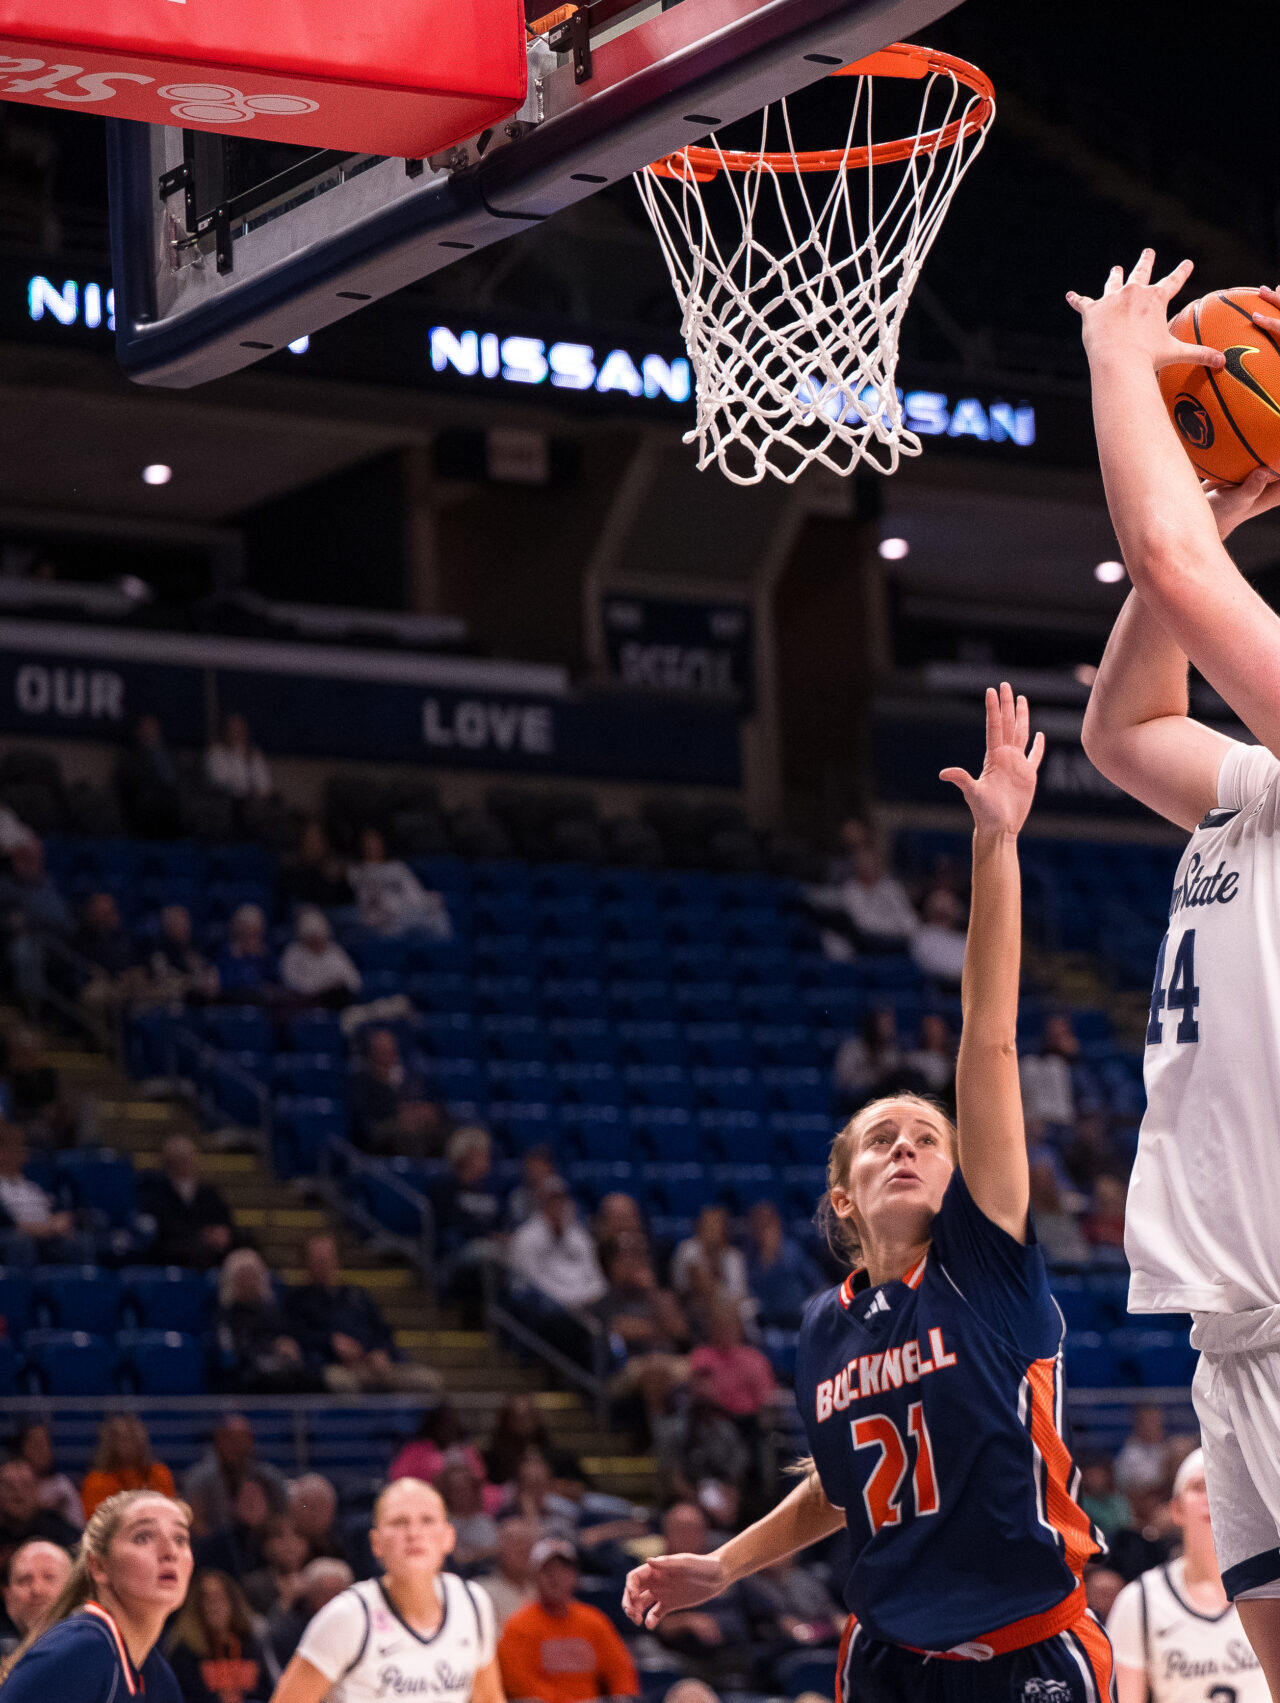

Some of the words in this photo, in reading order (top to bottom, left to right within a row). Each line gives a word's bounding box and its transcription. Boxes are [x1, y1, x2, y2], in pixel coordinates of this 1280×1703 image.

[428, 326, 691, 402] NISSAN
[15, 664, 126, 721] OUR
[422, 698, 557, 755] LOVE
[1183, 853, 1240, 908] State
[816, 1326, 957, 1424] BUCKNELL
[850, 1401, 940, 1536] 21
